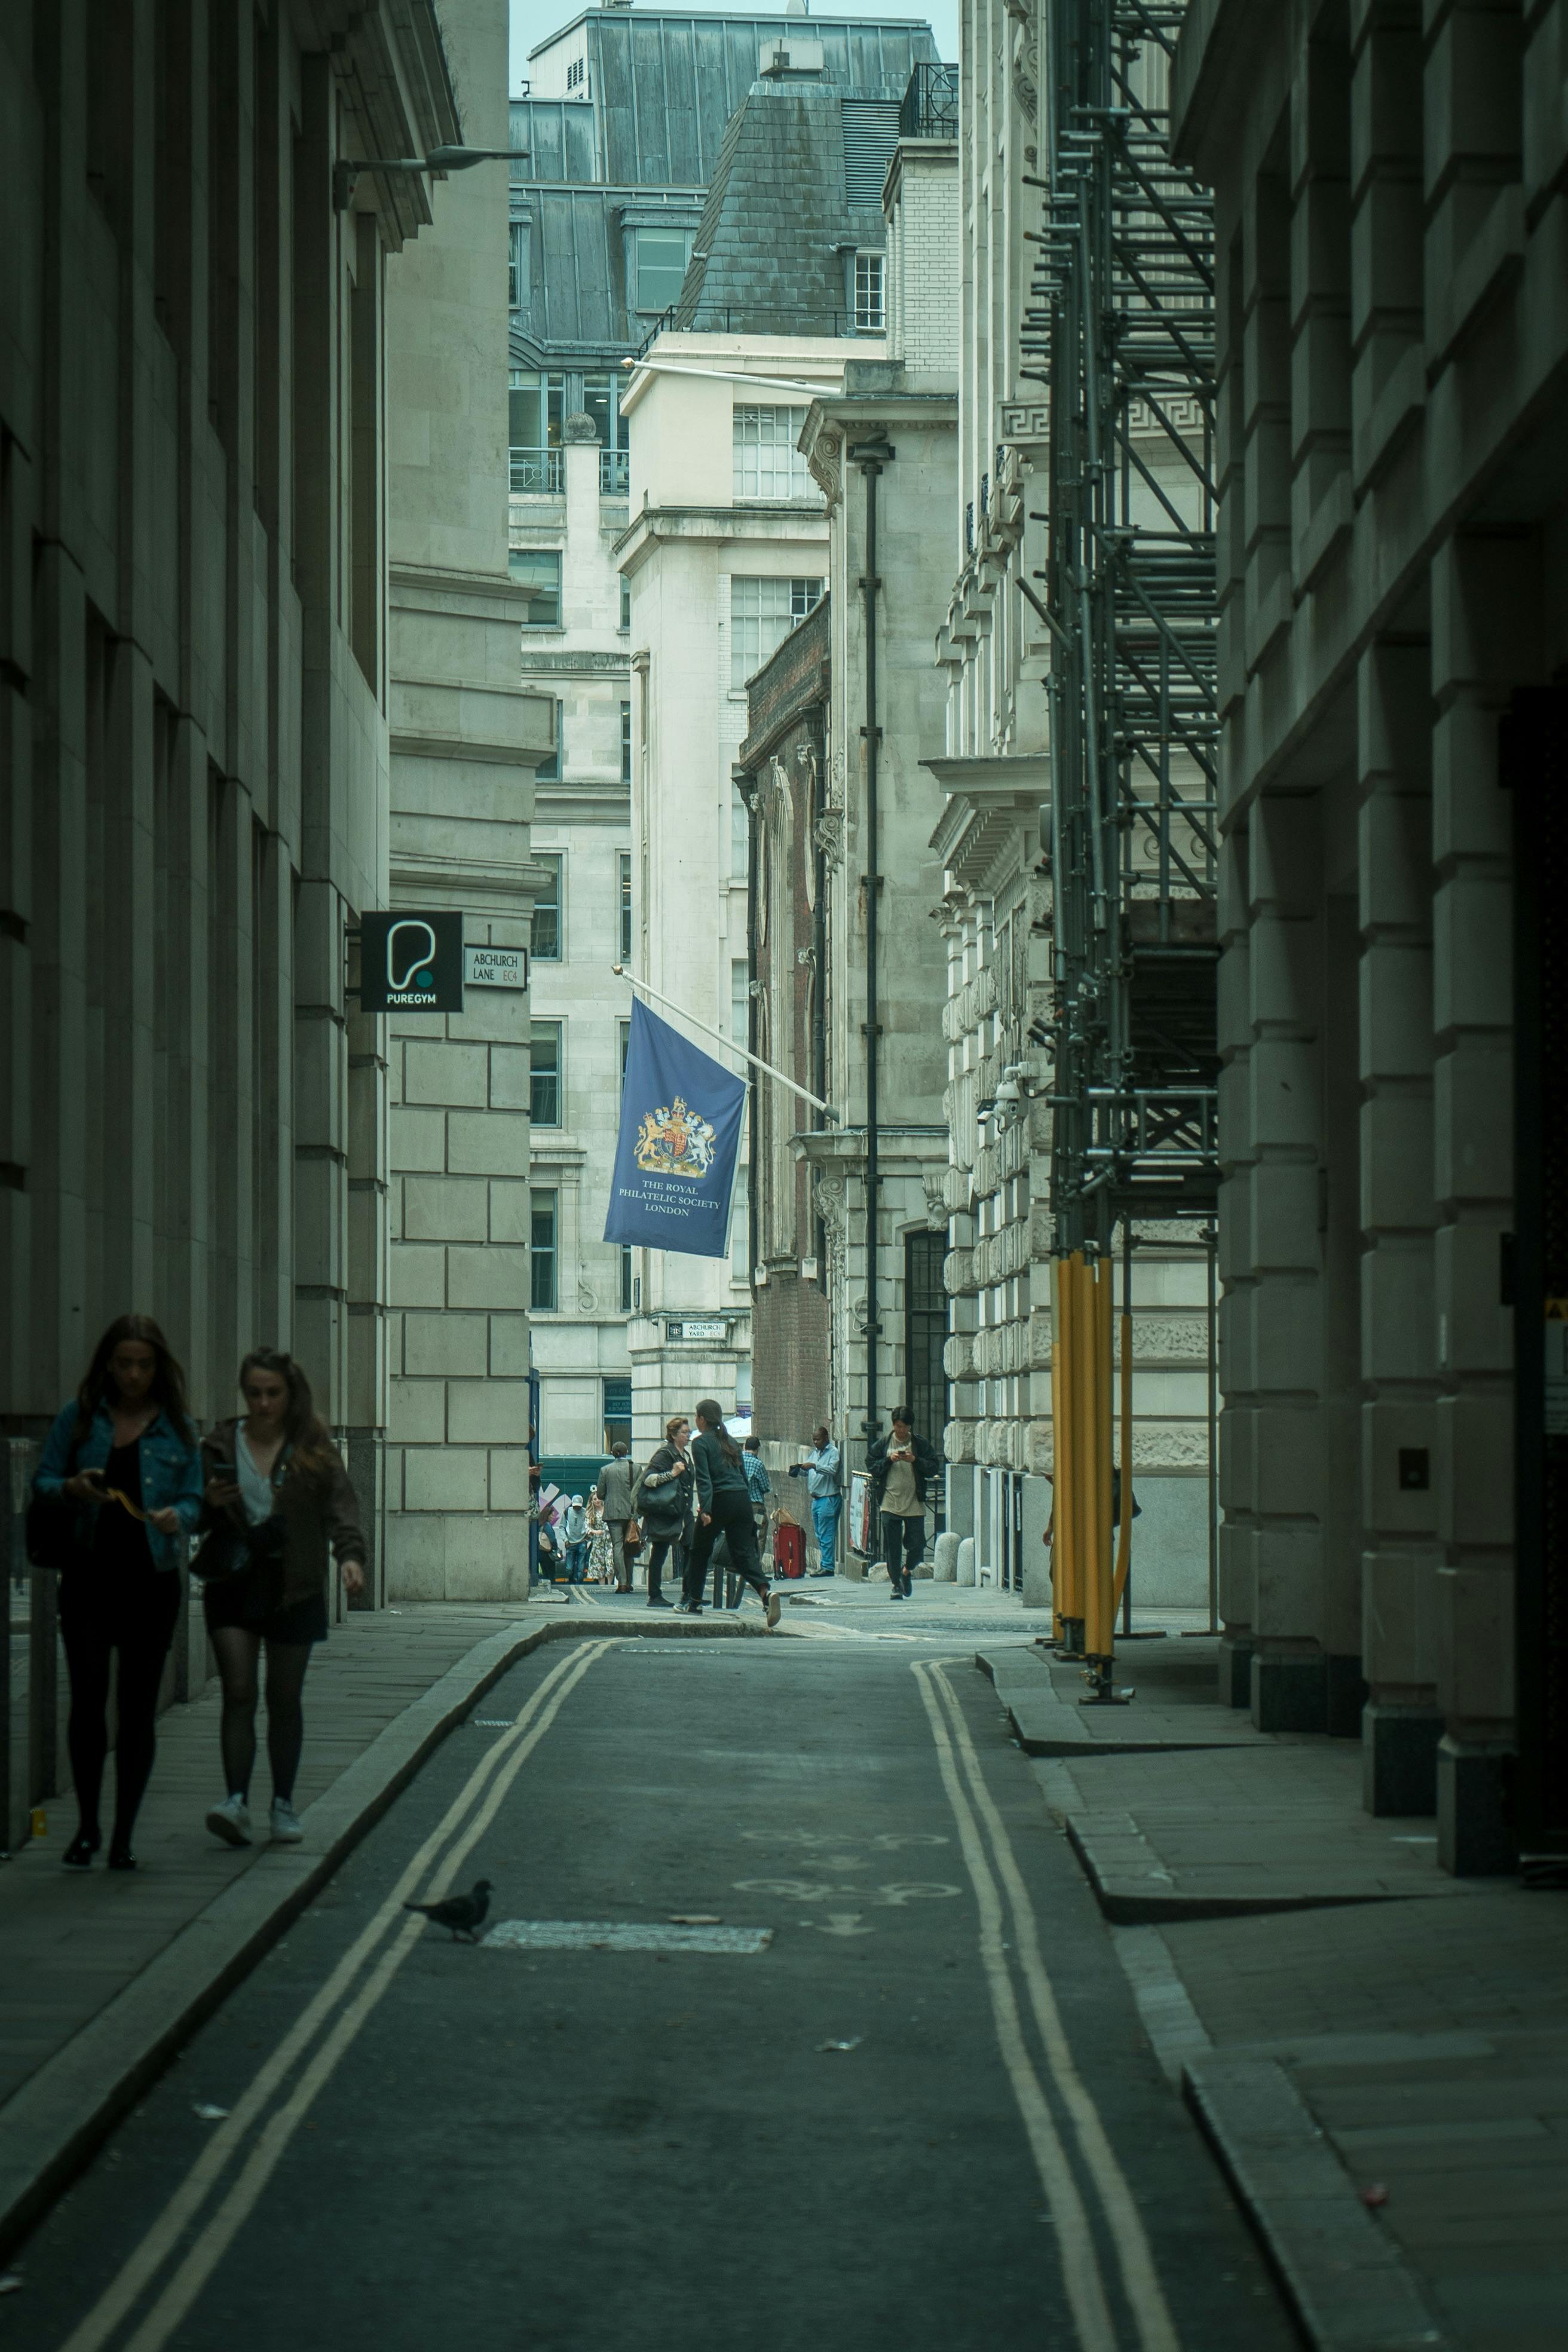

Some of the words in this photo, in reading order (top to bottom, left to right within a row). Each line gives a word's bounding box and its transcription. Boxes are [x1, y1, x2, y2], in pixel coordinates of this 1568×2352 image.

[474, 954, 517, 967] ABCHURCH
[473, 968, 494, 981] LANE
[503, 971, 517, 982] EC4
[387, 994, 436, 1004] PUREGYM
[642, 1180, 663, 1190] THE
[666, 1183, 699, 1195] ROYAL
[619, 1188, 676, 1203] PHILATELIC
[678, 1196, 721, 1209] SOCIETY
[645, 1203, 690, 1217] LONDON
